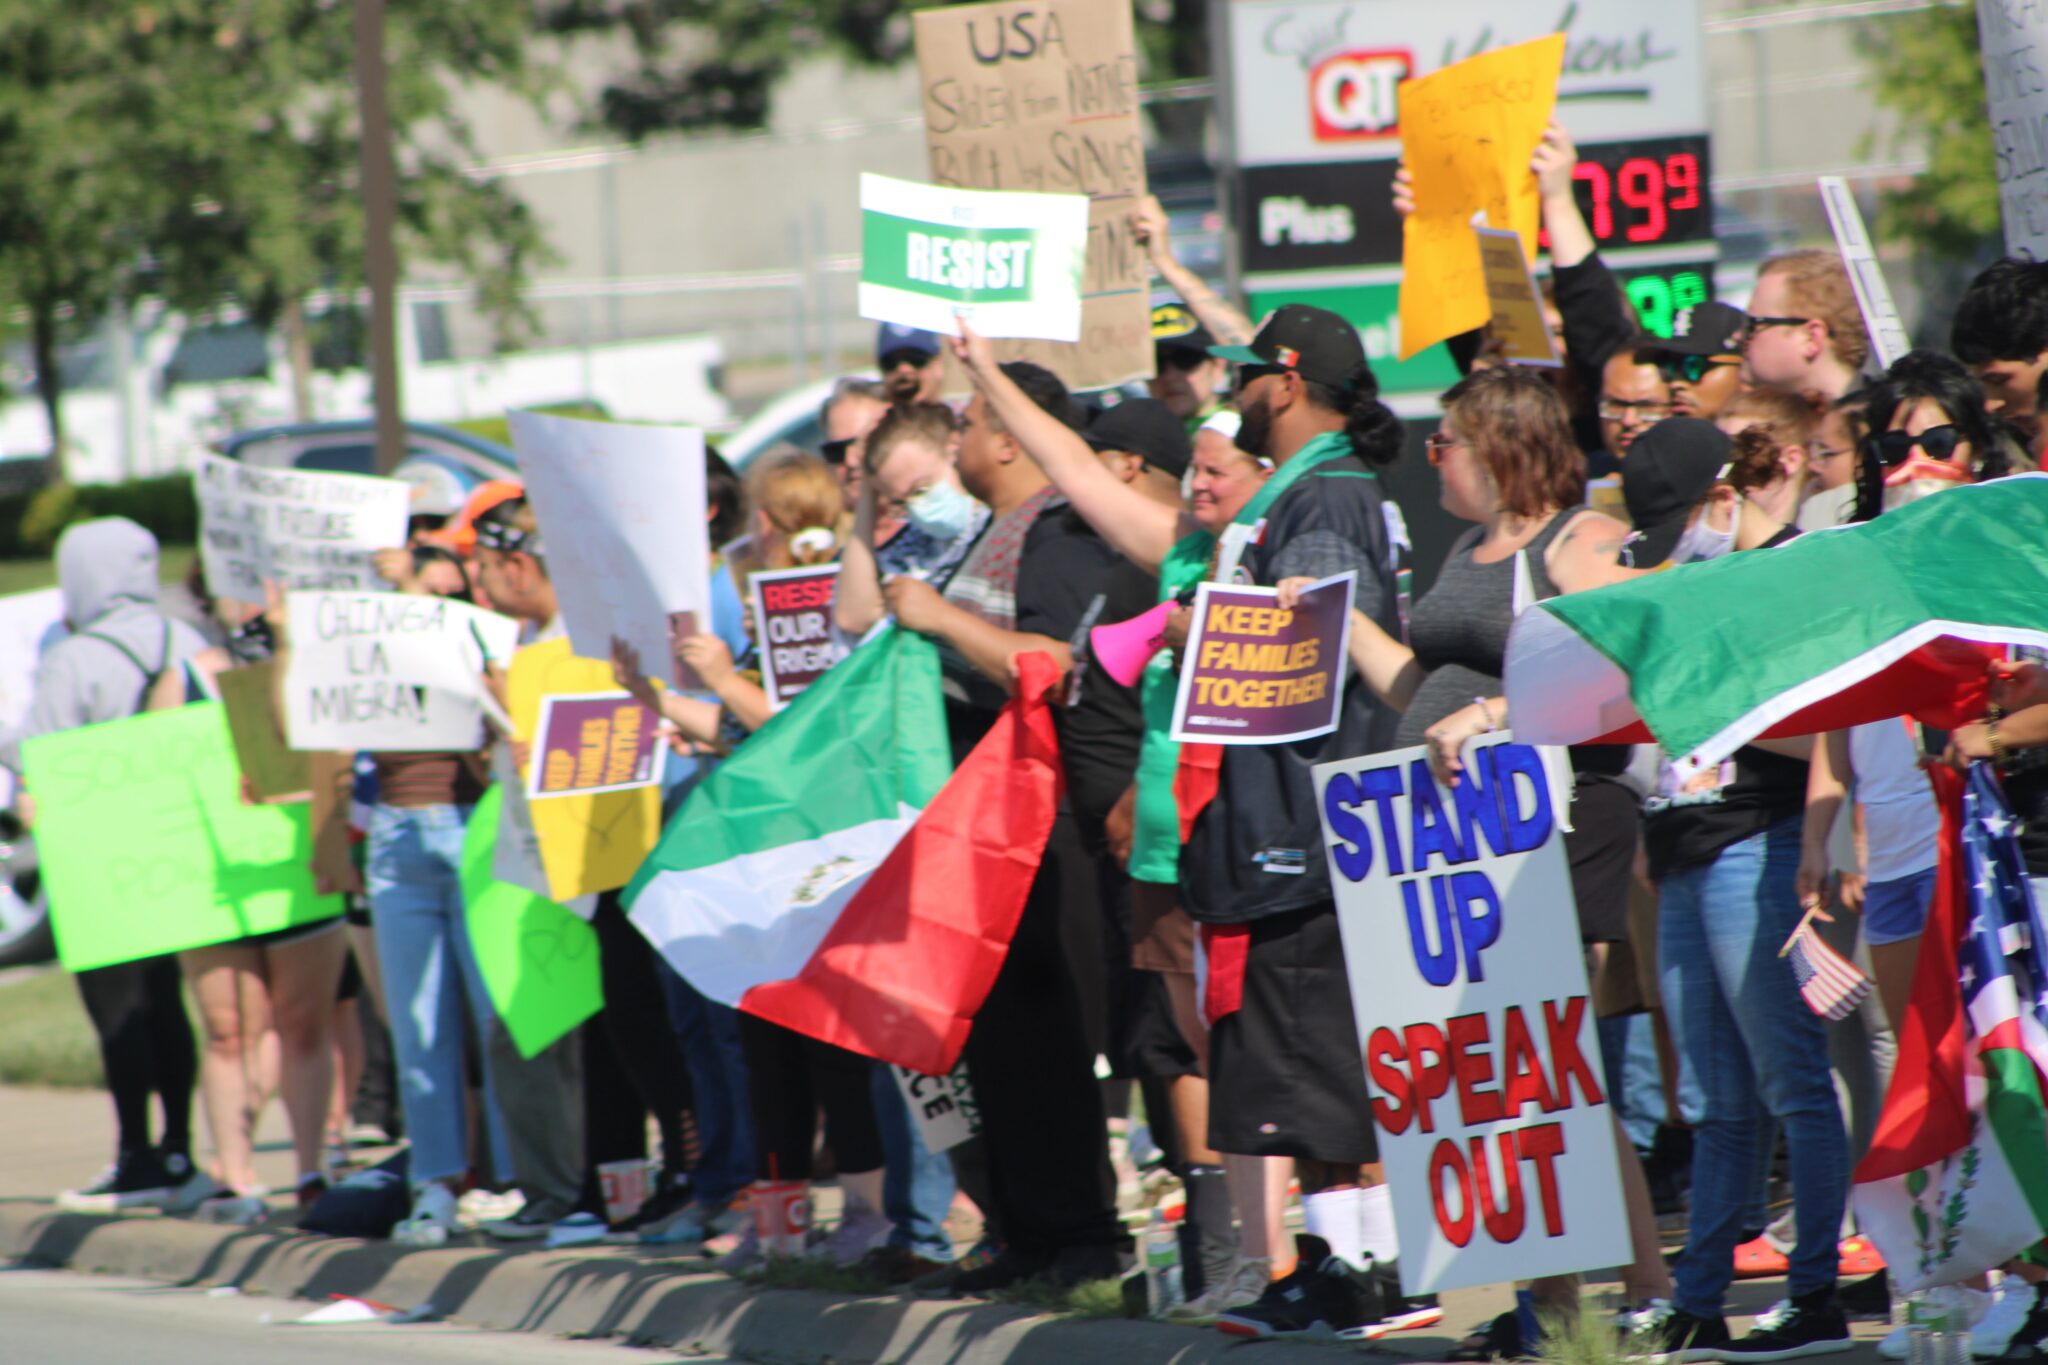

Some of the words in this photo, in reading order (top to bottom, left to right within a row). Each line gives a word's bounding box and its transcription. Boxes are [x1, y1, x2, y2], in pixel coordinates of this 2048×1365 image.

[966, 10, 1068, 65] USA
[1316, 57, 1408, 131] QT
[1260, 196, 1355, 245] Plus
[1562, 153, 1699, 246] 799
[906, 231, 1032, 290] RESIST
[315, 595, 447, 641] CHINGA
[769, 612, 827, 643] OUR
[1206, 604, 1295, 637] KEEP
[346, 642, 390, 676] LA
[1198, 637, 1321, 673] FAMILIES
[1193, 671, 1329, 709] TOGETHER
[1324, 742, 1553, 882] STAND
[1401, 870, 1502, 987] UP
[1367, 995, 1606, 1136] SPEAK
[1428, 1120, 1566, 1249] OUT
